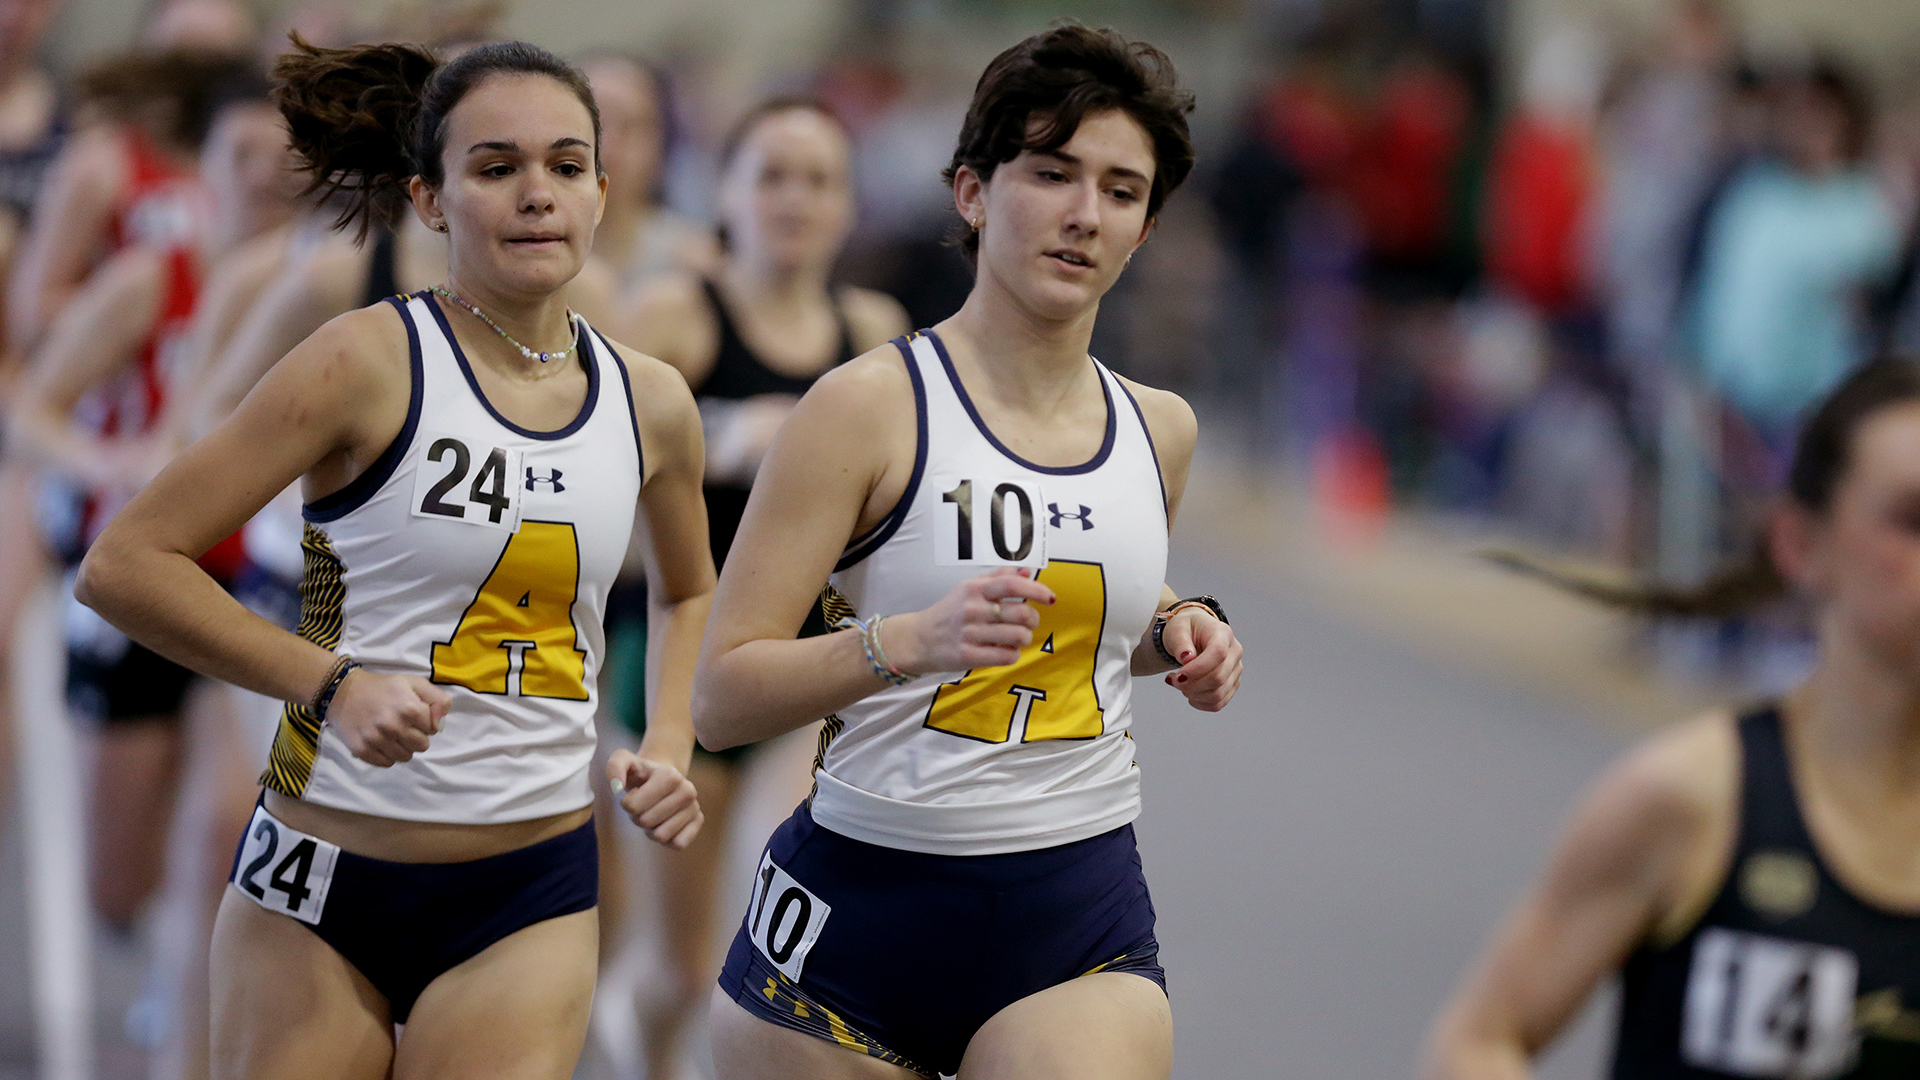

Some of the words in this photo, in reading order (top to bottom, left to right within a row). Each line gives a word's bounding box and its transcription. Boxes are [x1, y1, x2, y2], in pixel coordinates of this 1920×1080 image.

[420, 438, 510, 525] 24
[942, 479, 1034, 562] 10
[430, 519, 589, 702] A
[239, 818, 318, 913] 24
[751, 863, 813, 966] 10
[1716, 948, 1822, 1056] 14
